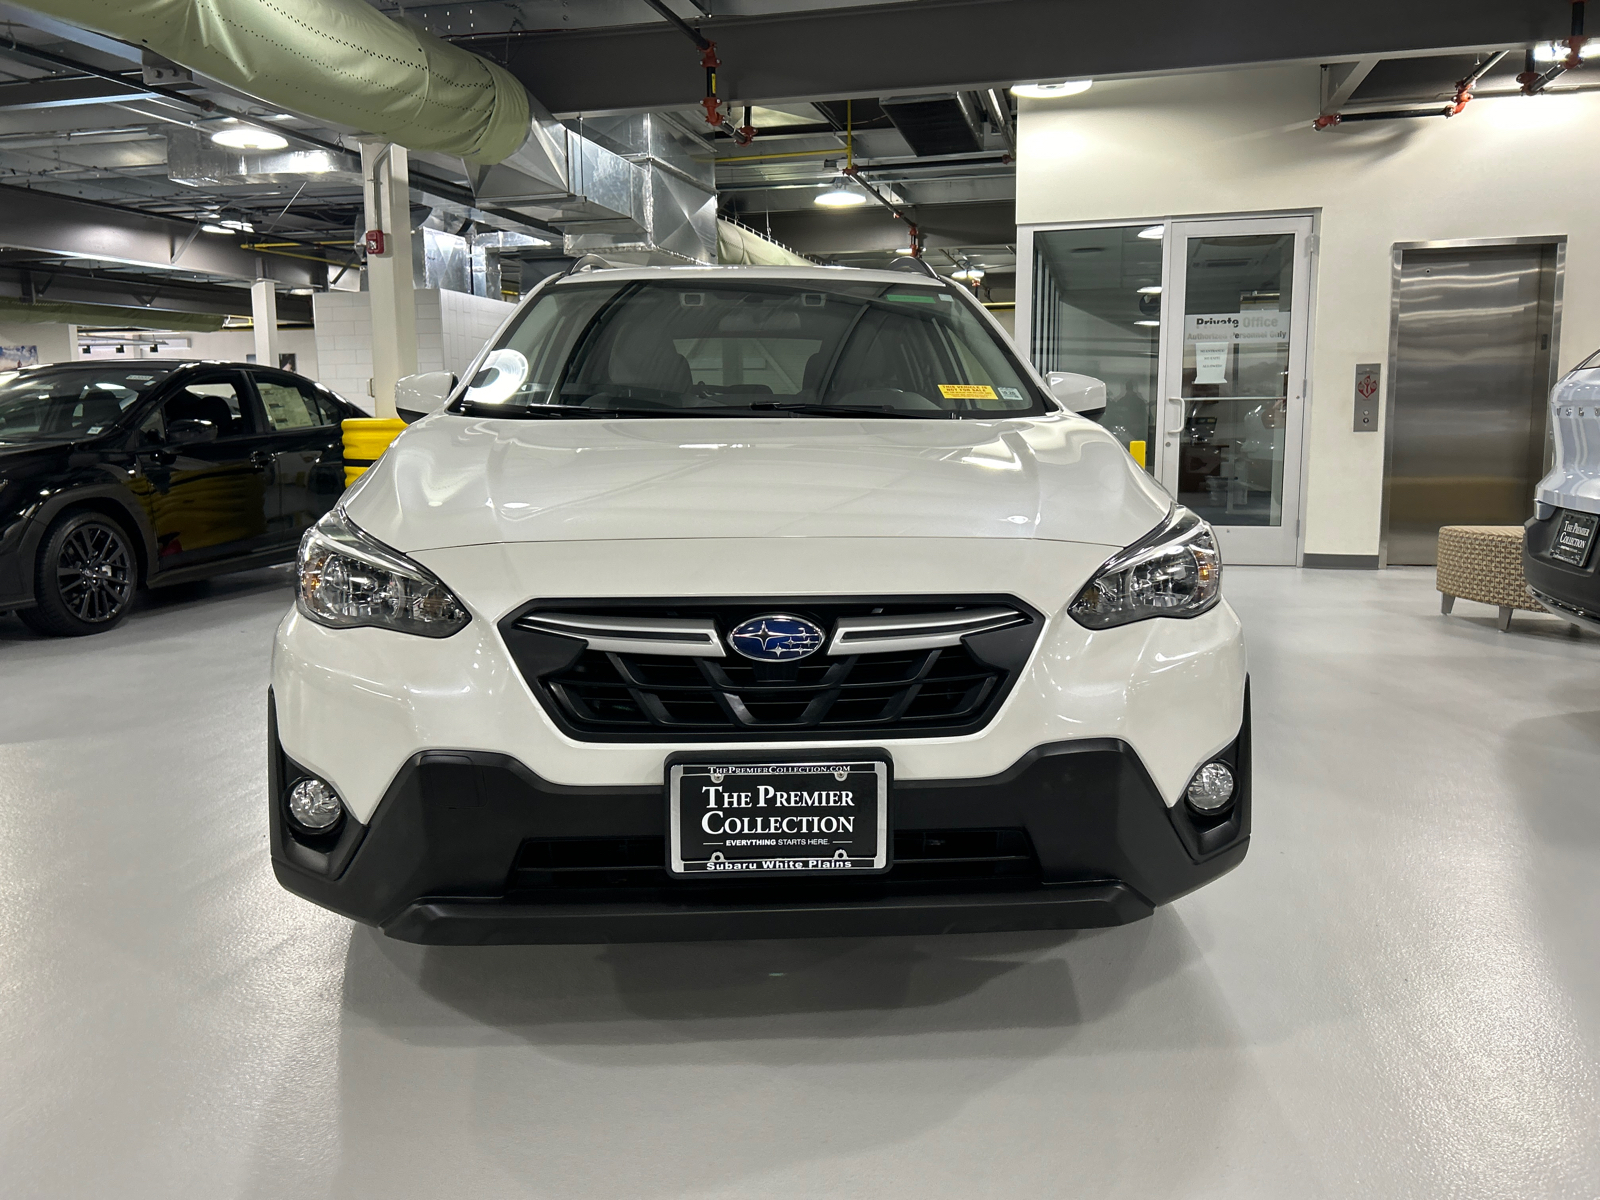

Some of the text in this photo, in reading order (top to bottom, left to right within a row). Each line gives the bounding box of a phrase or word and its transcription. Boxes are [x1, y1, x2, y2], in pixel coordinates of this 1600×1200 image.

[1196, 316, 1279, 329] Private Office
[1269, 330, 1287, 339] Only
[725, 838, 776, 847] EVERYTHING
[777, 838, 806, 846] STARTS
[706, 859, 852, 871] Subaru White Plains
